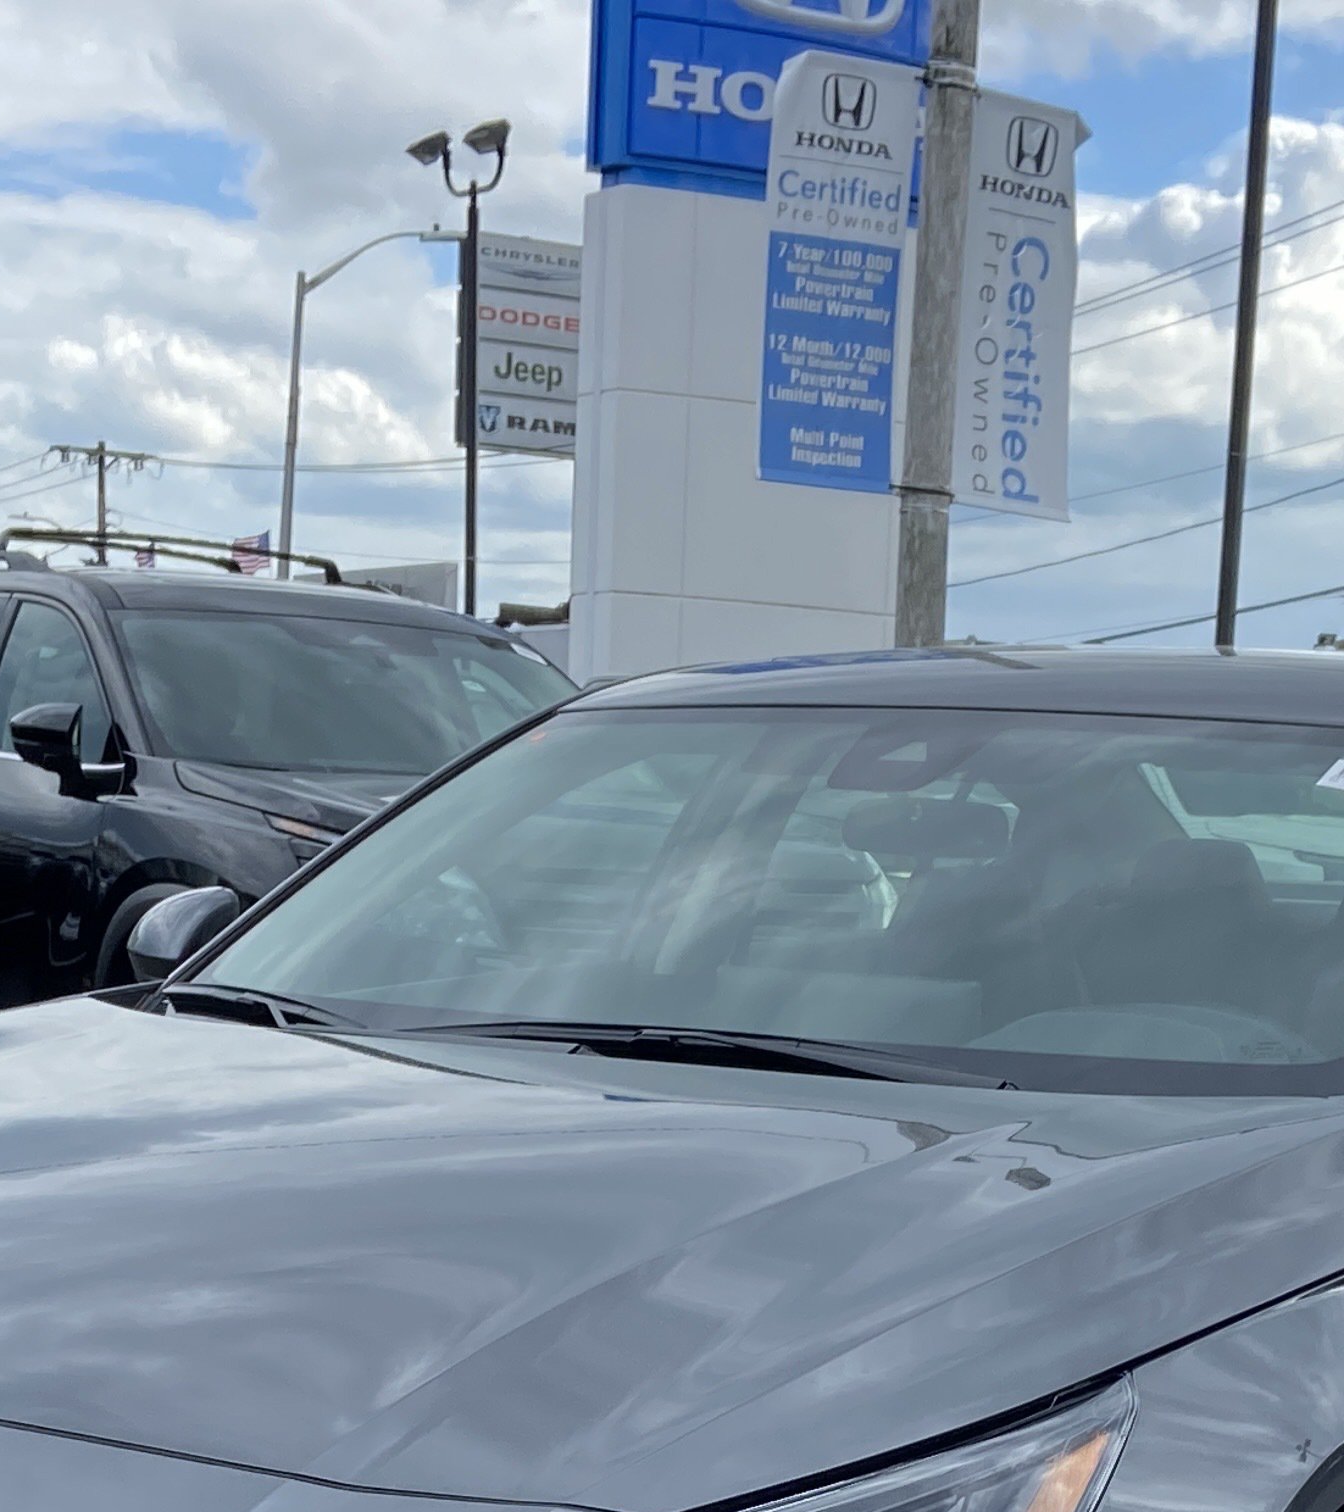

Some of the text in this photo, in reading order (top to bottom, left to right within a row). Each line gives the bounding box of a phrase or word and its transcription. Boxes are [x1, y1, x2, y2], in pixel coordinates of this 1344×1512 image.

[795, 131, 893, 160] HONDA
[778, 170, 902, 212] Certified
[979, 174, 1071, 209] HONDA
[777, 202, 898, 235] Pre-Owned
[480, 247, 580, 268] CHRYSLER
[795, 276, 874, 302] Powertrain
[478, 305, 580, 332] DODGE
[773, 292, 891, 326] Limited Warranty
[494, 352, 563, 392] Jeep
[972, 231, 1006, 495] Pre-Owned
[1001, 236, 1049, 503] Certified
[790, 367, 869, 392] Powertrain
[768, 384, 887, 416] Limited Warranty
[507, 415, 576, 437] RAM
[791, 445, 862, 468] Inspection
